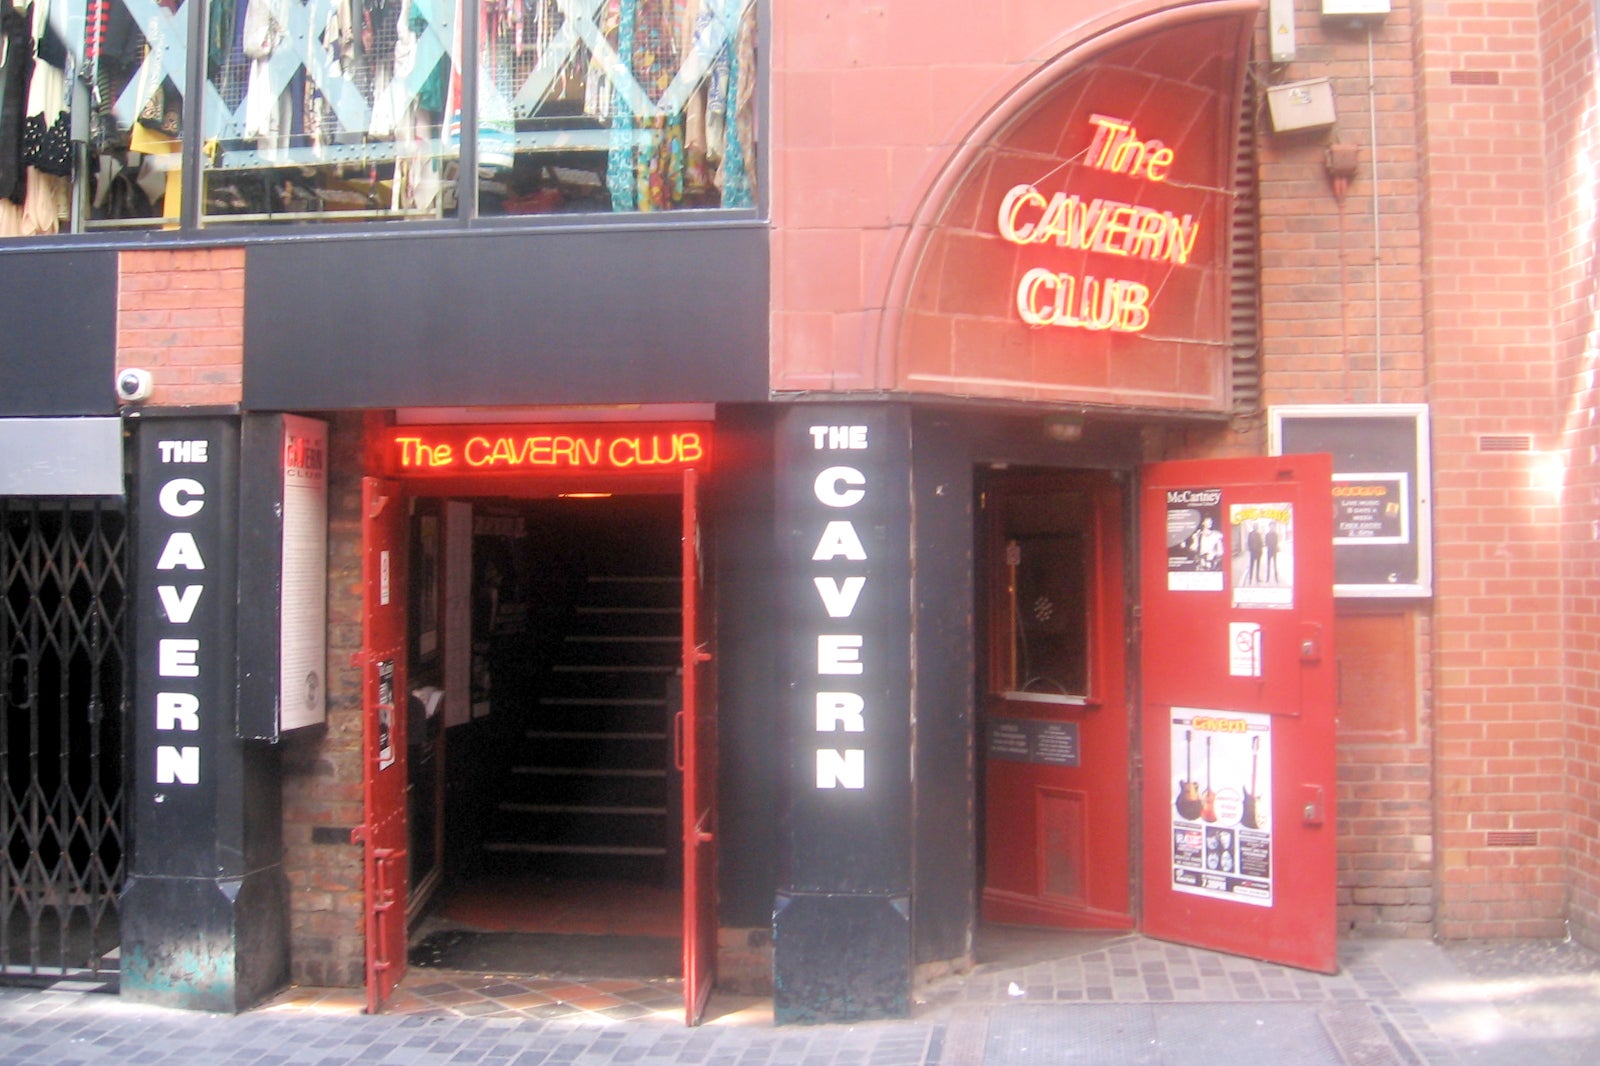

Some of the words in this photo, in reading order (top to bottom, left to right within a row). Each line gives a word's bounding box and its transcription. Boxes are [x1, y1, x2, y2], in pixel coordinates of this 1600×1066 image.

[1083, 113, 1174, 182] The
[998, 184, 1199, 264] CAVERN
[1017, 267, 1149, 333] CLUB
[158, 440, 208, 463] THE
[395, 436, 453, 467] The
[464, 435, 601, 467] CAVERN
[608, 432, 703, 467] CLUB
[809, 426, 868, 450] THE
[1167, 490, 1222, 504] McCartney
[156, 478, 205, 785] CAVERN
[811, 465, 868, 789] CAVERN
[1192, 716, 1249, 733] cavern
